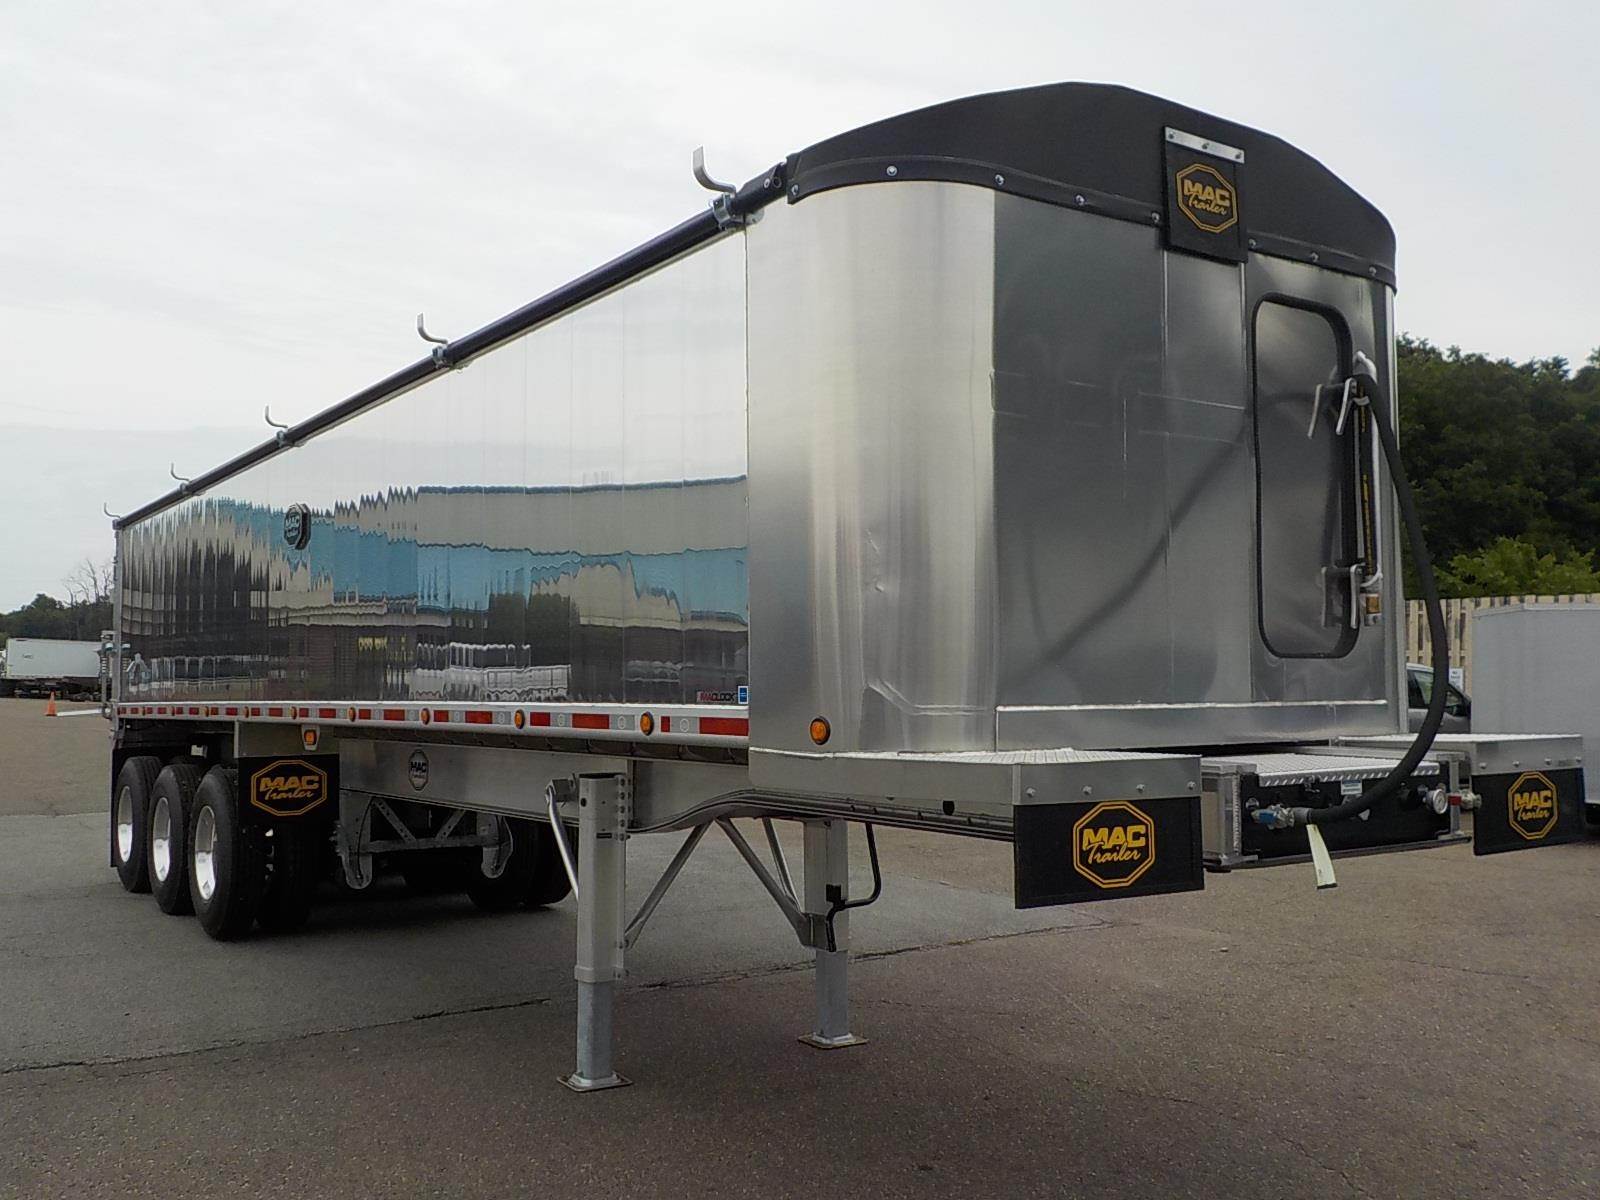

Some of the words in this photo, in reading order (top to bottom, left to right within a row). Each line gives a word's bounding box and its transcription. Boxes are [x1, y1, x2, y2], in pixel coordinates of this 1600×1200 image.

[1183, 179, 1231, 207] MAC
[259, 775, 320, 792] MAC
[1513, 790, 1552, 810] MAC
[1082, 825, 1146, 850] MAC
[1086, 842, 1141, 864] Trailer
